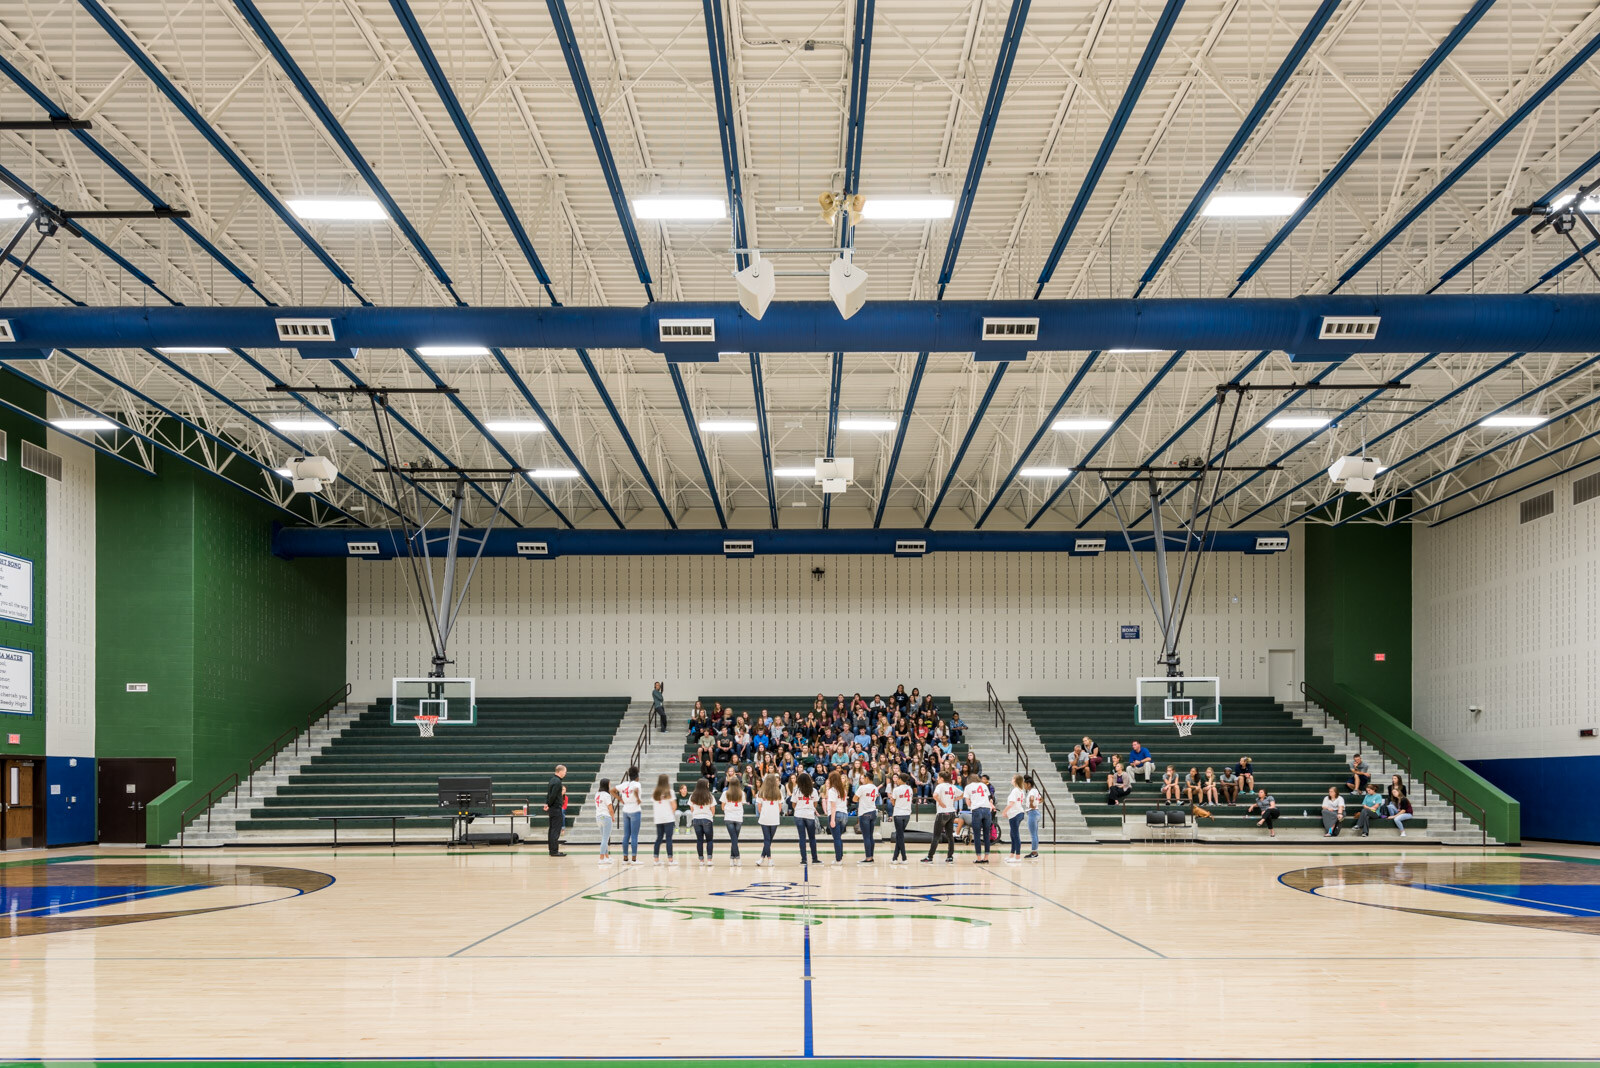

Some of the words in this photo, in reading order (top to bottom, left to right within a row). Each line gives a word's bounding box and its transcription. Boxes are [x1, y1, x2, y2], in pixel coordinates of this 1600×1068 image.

[6, 653, 23, 662] MATER
[624, 786, 630, 798] 4
[870, 788, 876, 801] 4
[904, 788, 910, 801] 4
[948, 786, 954, 799] 4
[977, 785, 985, 797] 4
